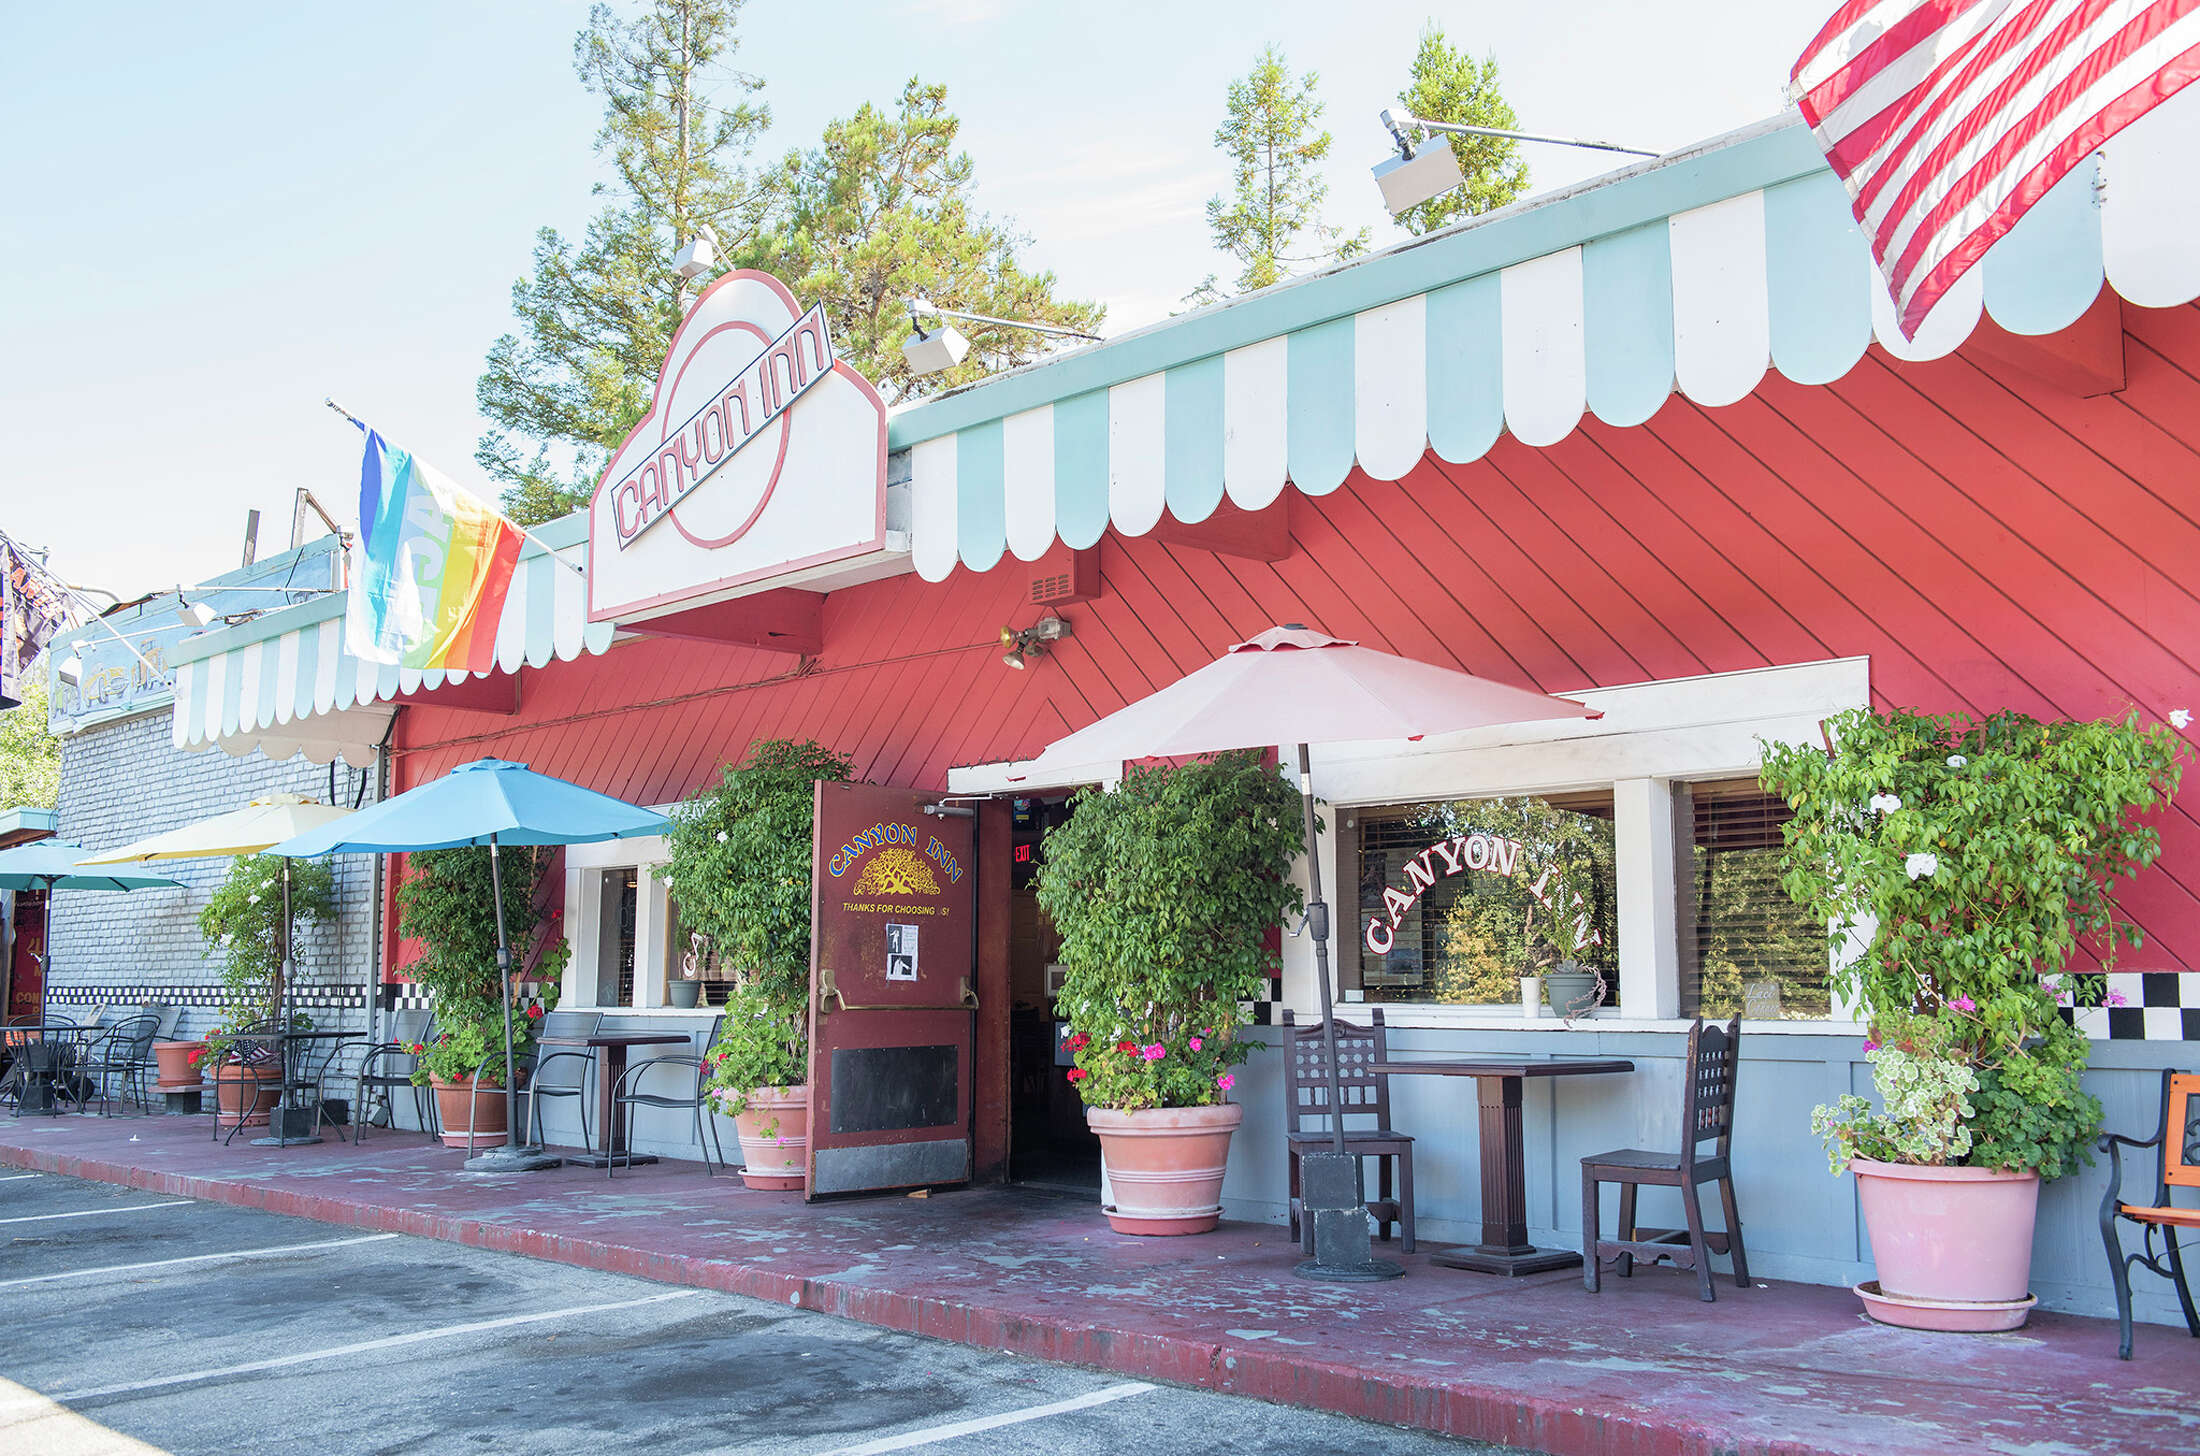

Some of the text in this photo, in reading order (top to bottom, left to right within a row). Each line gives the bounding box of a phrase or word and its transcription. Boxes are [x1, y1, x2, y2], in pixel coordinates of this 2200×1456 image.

[618, 311, 825, 538] CANYON INN
[829, 823, 963, 884] CANYON INN
[1015, 844, 1030, 862] EXIT
[842, 903, 875, 913] THANKS
[876, 904, 893, 913] FOR
[895, 904, 935, 915] CHOOSING
[1366, 834, 1522, 955] CANYON
